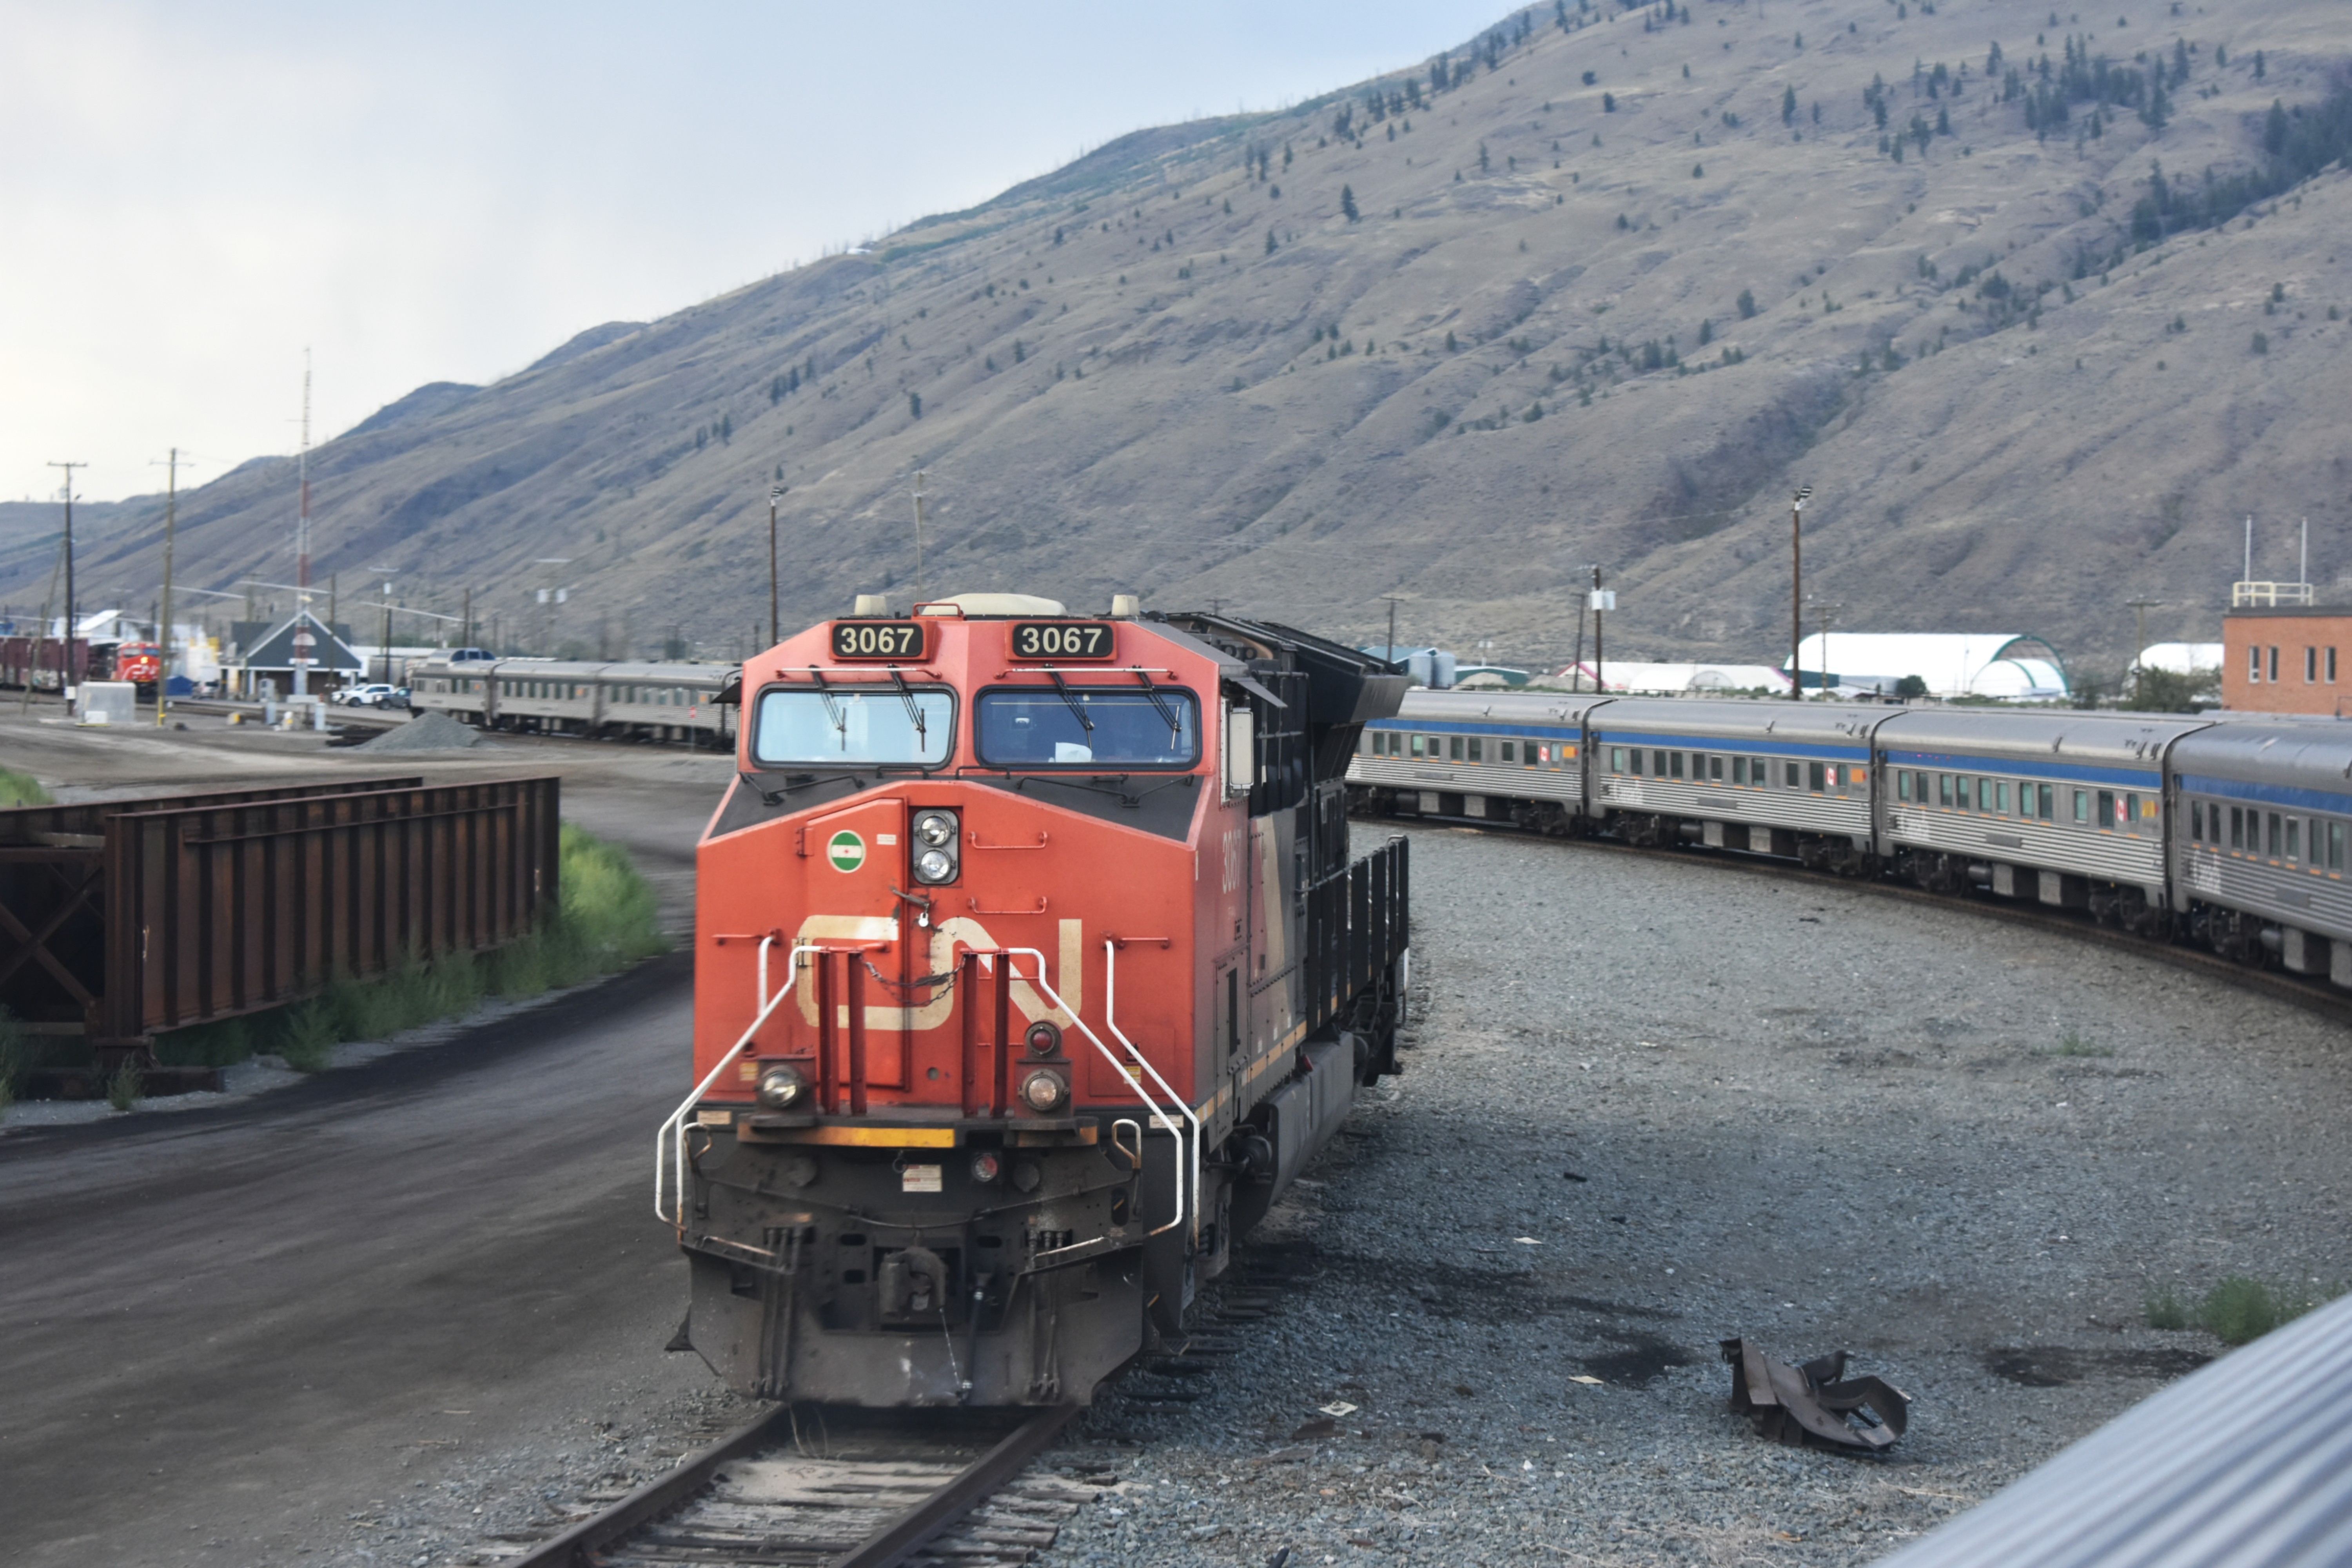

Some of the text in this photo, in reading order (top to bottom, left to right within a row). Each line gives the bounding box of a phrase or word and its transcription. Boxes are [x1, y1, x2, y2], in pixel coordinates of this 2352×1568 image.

[841, 627, 914, 653] 3067
[1022, 627, 1102, 653] 3067
[1223, 829, 1241, 894] 3067
[796, 915, 1082, 1031] CN
